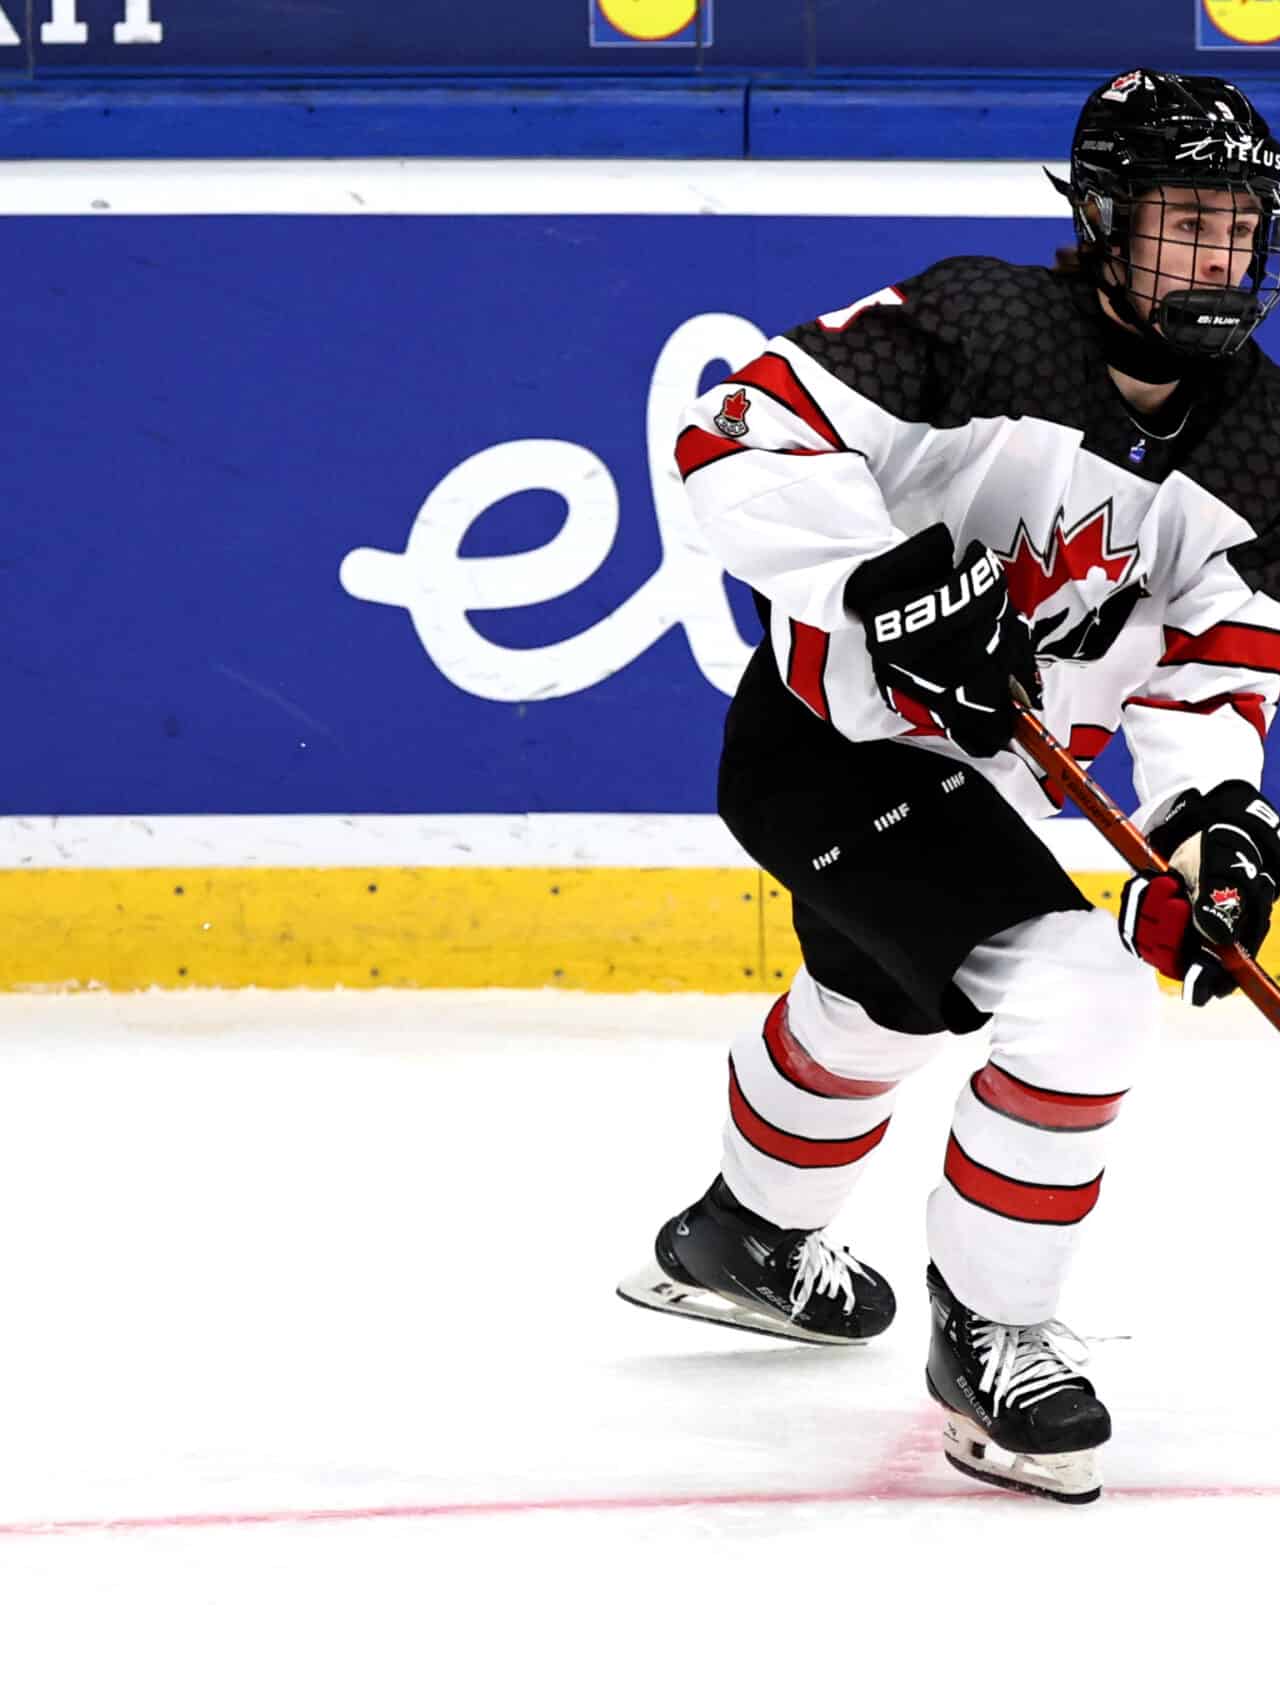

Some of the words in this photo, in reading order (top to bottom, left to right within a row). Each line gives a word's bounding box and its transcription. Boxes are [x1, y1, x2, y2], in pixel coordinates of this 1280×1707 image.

[1224, 139, 1280, 170] TELUS
[941, 771, 965, 794] IIHF
[873, 802, 911, 832] IIHF
[812, 846, 841, 871] IHF
